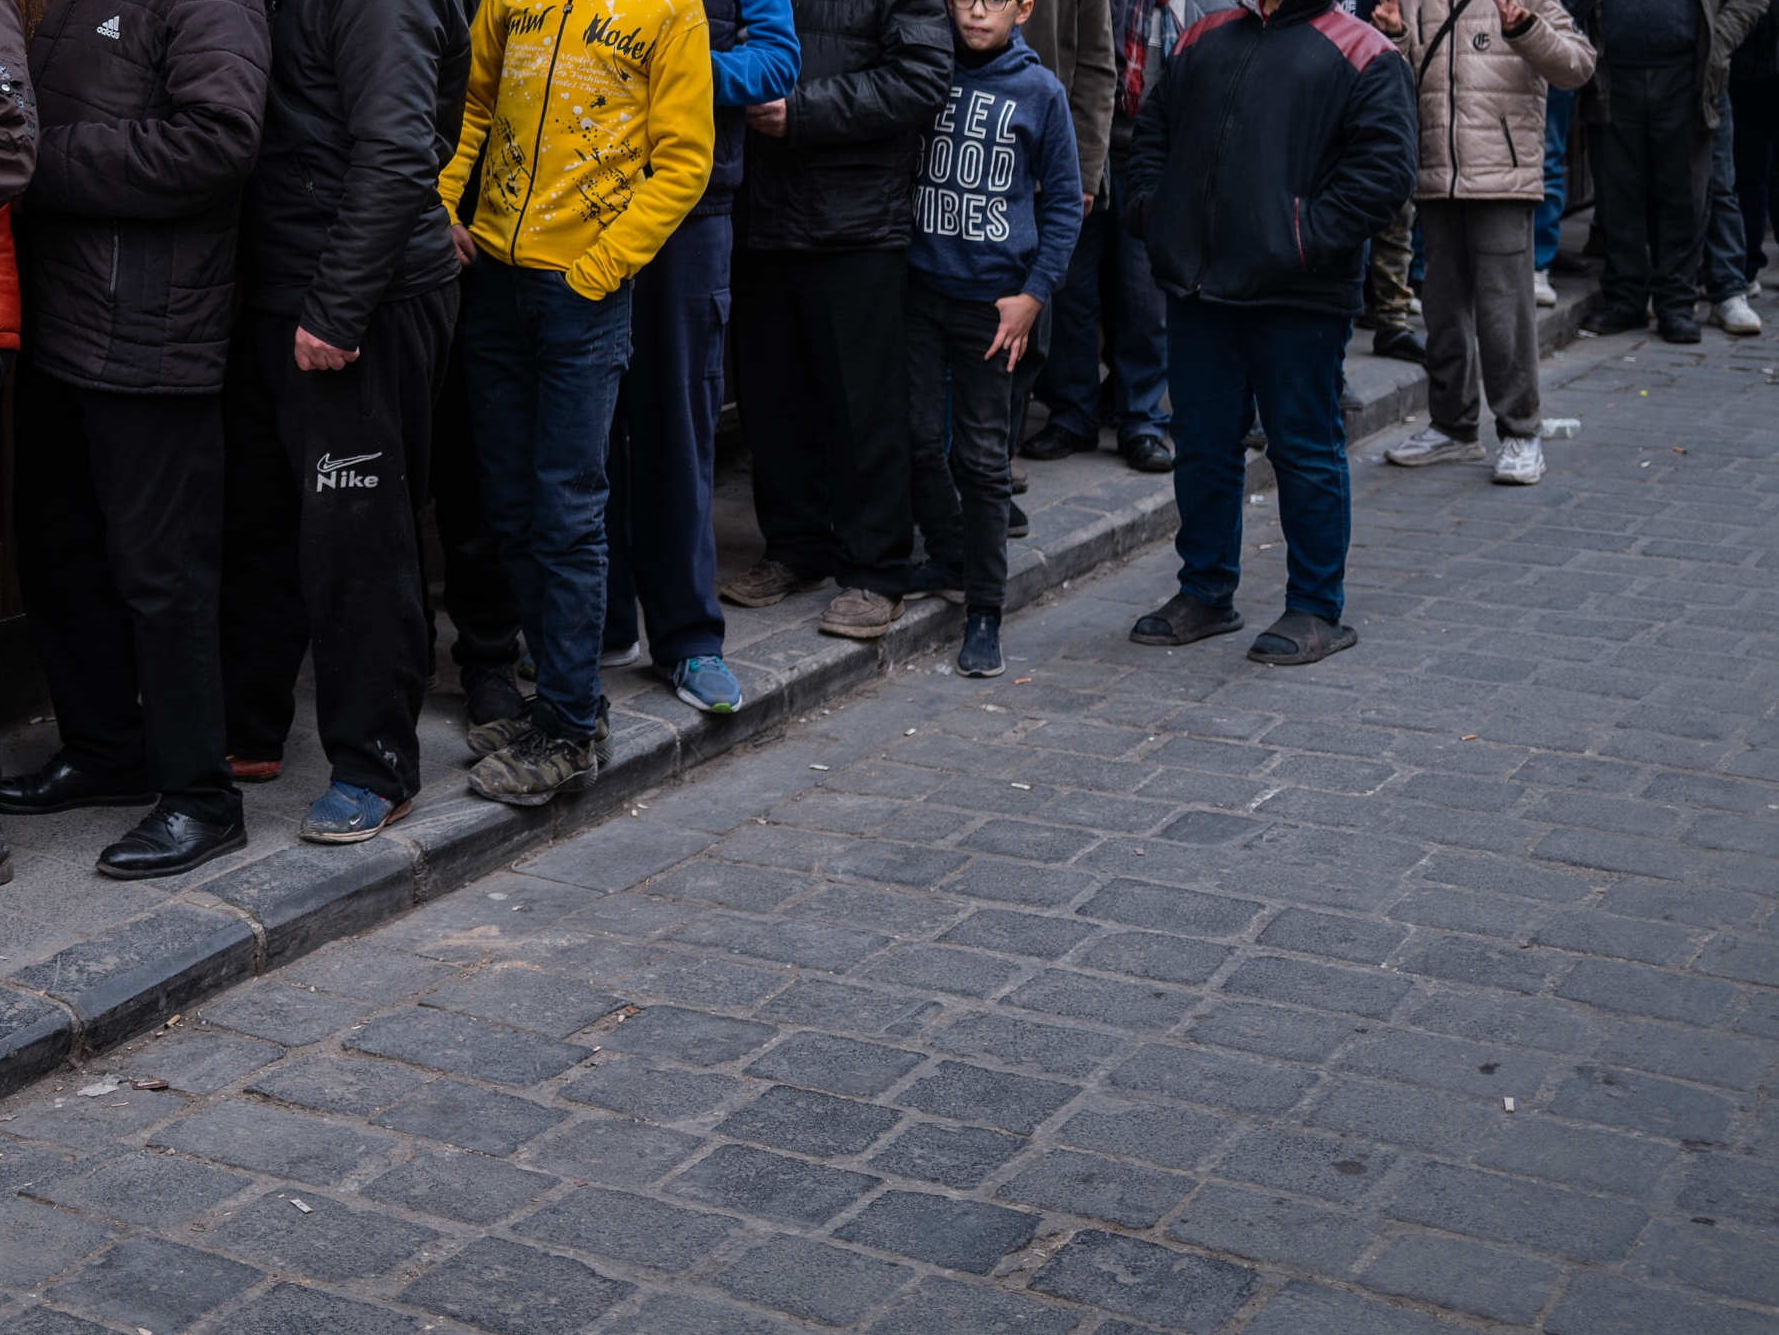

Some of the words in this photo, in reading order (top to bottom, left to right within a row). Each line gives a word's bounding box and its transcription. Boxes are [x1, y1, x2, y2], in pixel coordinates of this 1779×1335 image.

[96, 26, 120, 40] adidas
[582, 13, 657, 66] Model
[571, 70, 609, 86] Fashion
[934, 86, 1017, 144] EEL
[316, 470, 379, 493] Nike
